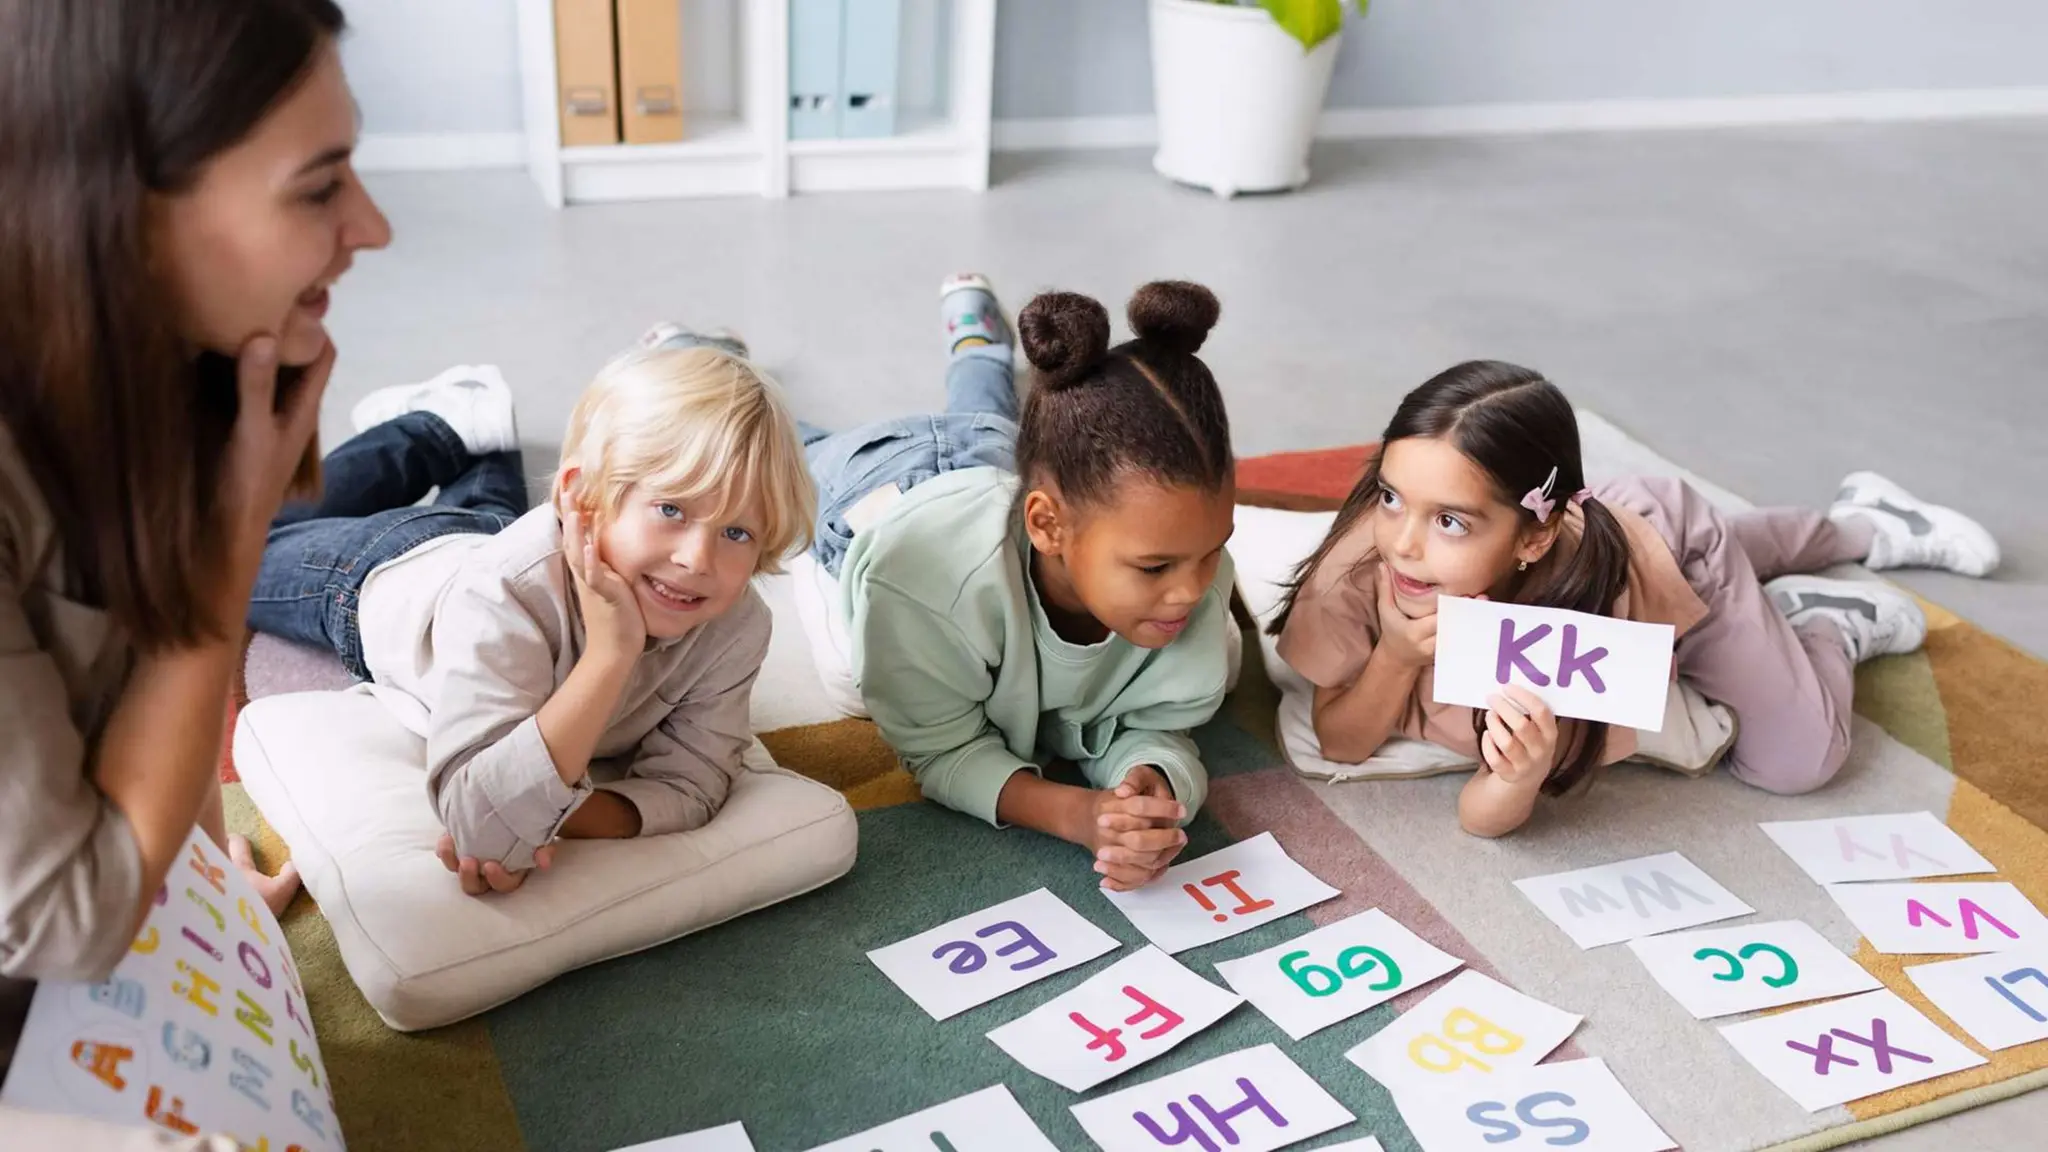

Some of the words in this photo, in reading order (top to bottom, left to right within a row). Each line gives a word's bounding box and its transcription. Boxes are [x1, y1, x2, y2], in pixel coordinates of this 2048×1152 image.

[1495, 618, 1609, 694] Kk
[1182, 869, 1276, 923] Ii
[1557, 870, 1715, 919] Ww
[1906, 897, 2021, 941] Vv
[932, 920, 1059, 974] Ee
[1278, 944, 1404, 998] Gg
[1692, 942, 1800, 989] Cc
[1068, 984, 1186, 1063] Ff
[1407, 1006, 1526, 1074] Bb
[1785, 1017, 1934, 1076] Xx
[70, 1039, 134, 1092] A
[1132, 1077, 1289, 1152] Hh
[1465, 1090, 1591, 1147] Ss
